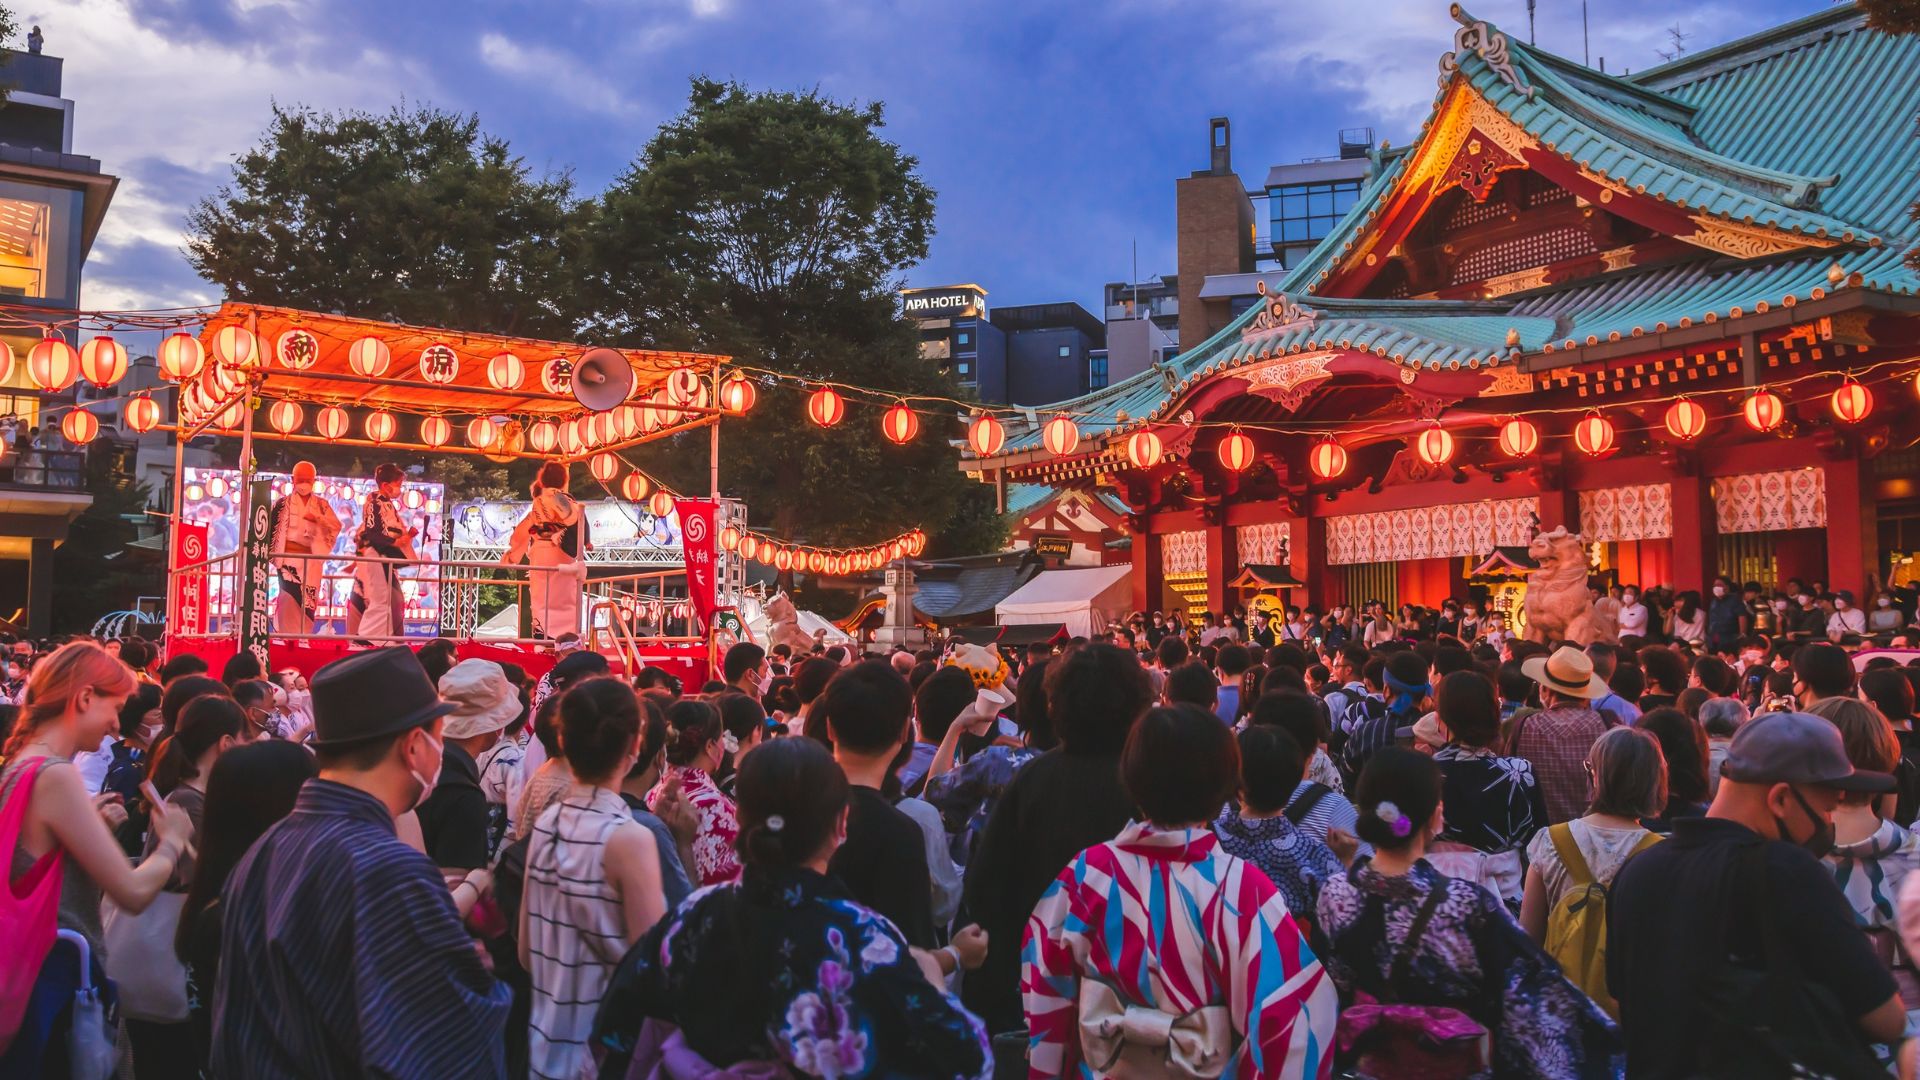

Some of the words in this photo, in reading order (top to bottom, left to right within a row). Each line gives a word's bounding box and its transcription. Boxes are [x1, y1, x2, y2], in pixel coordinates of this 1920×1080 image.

[906, 299, 929, 311] APA
[931, 295, 969, 308] HOTEL
[425, 347, 454, 376] 涼
